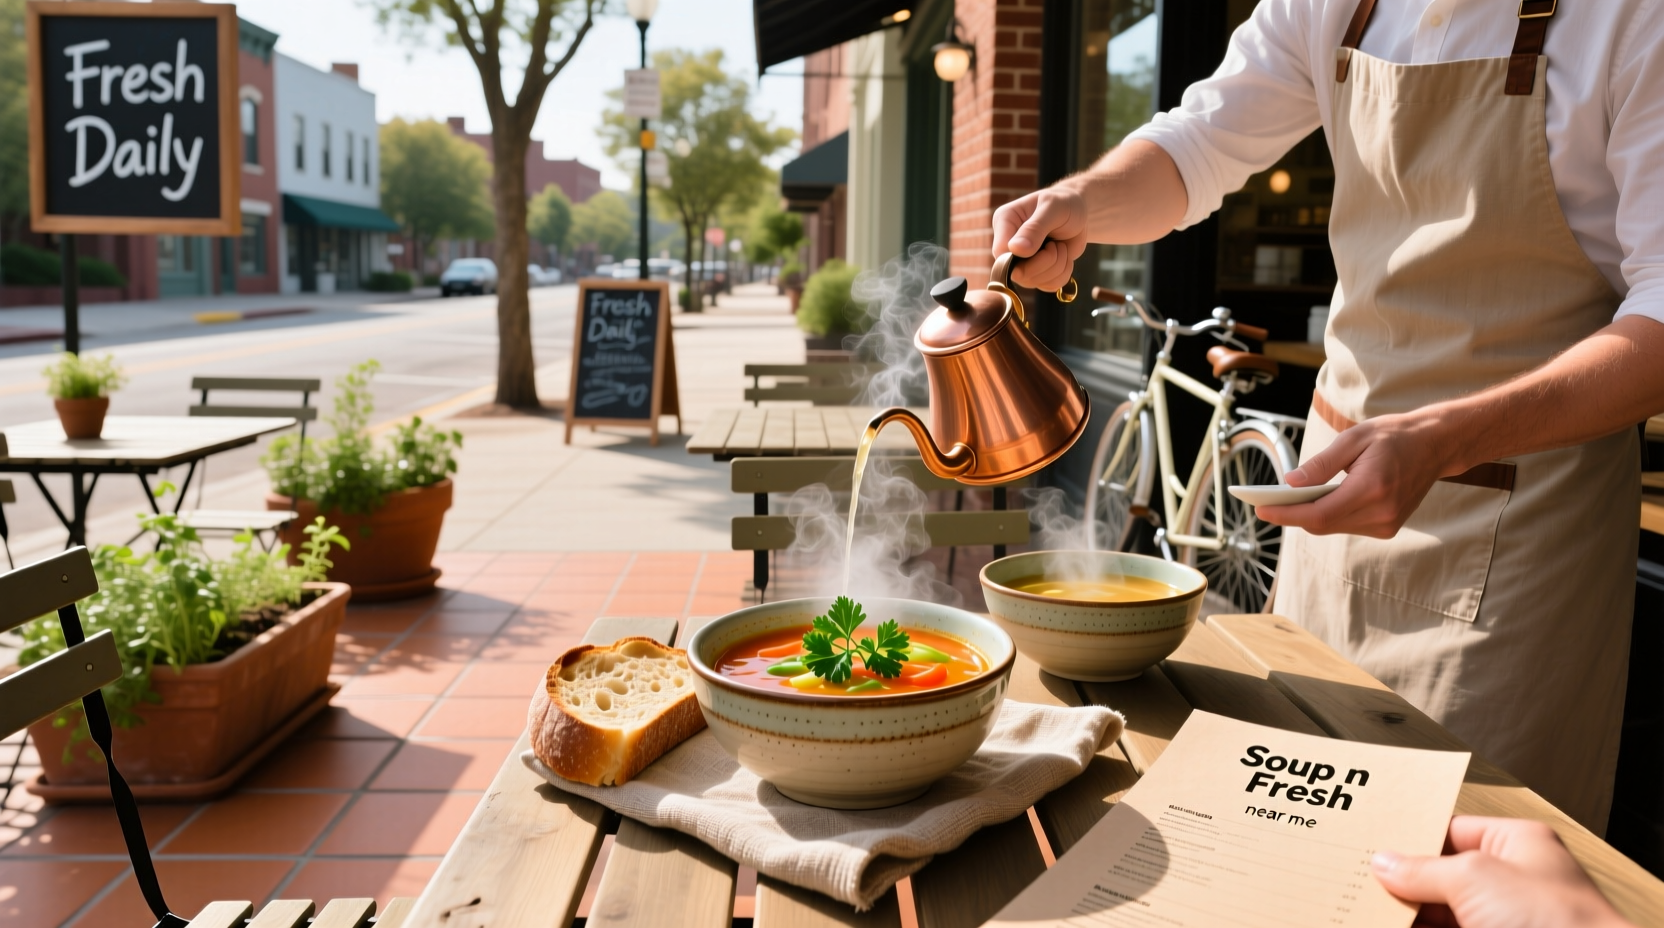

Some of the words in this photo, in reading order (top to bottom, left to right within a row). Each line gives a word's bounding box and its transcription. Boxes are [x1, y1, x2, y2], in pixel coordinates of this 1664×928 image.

[63, 38, 205, 110] Fresh
[64, 112, 204, 202] Daily
[590, 291, 653, 317] Fresh
[1240, 744, 1336, 785] Soup
[1344, 768, 1370, 787] n
[1244, 771, 1353, 811] Fresh
[1244, 805, 1286, 822] near
[1288, 814, 1317, 829] me
